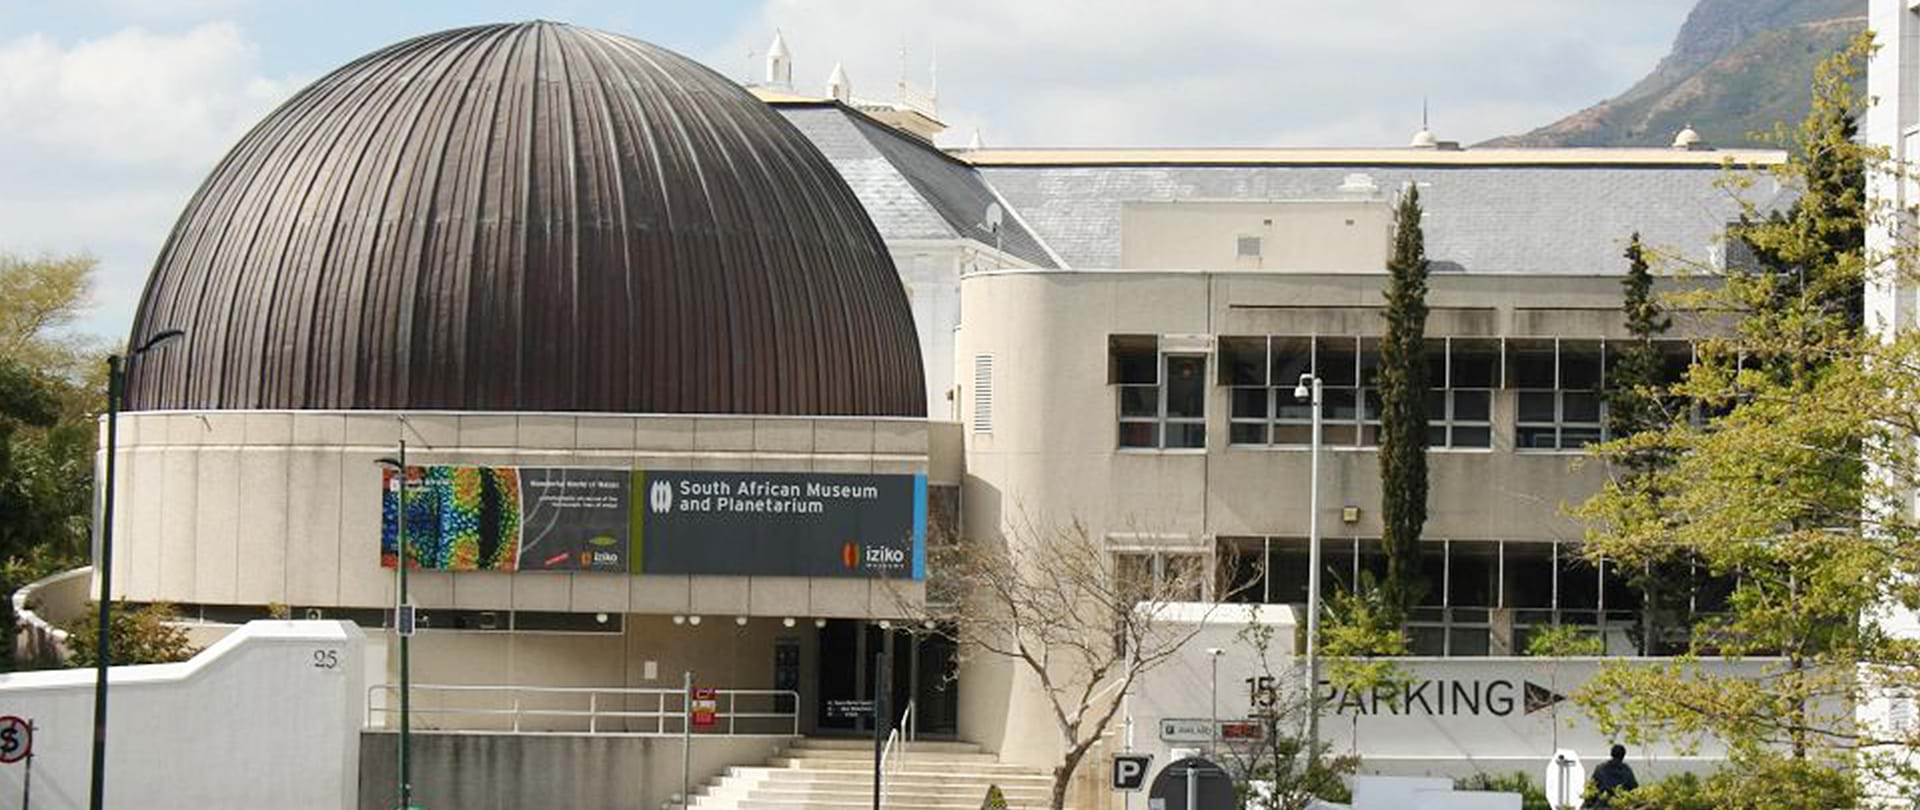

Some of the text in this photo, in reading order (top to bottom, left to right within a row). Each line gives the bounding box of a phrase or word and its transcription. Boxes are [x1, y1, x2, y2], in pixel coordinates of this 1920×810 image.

[680, 481, 878, 498] South African Museum
[680, 497, 823, 512] and Planetarium
[866, 545, 904, 563] iziko
[314, 650, 337, 669] 25
[1246, 676, 1276, 707] 15
[1117, 761, 1141, 785] P
